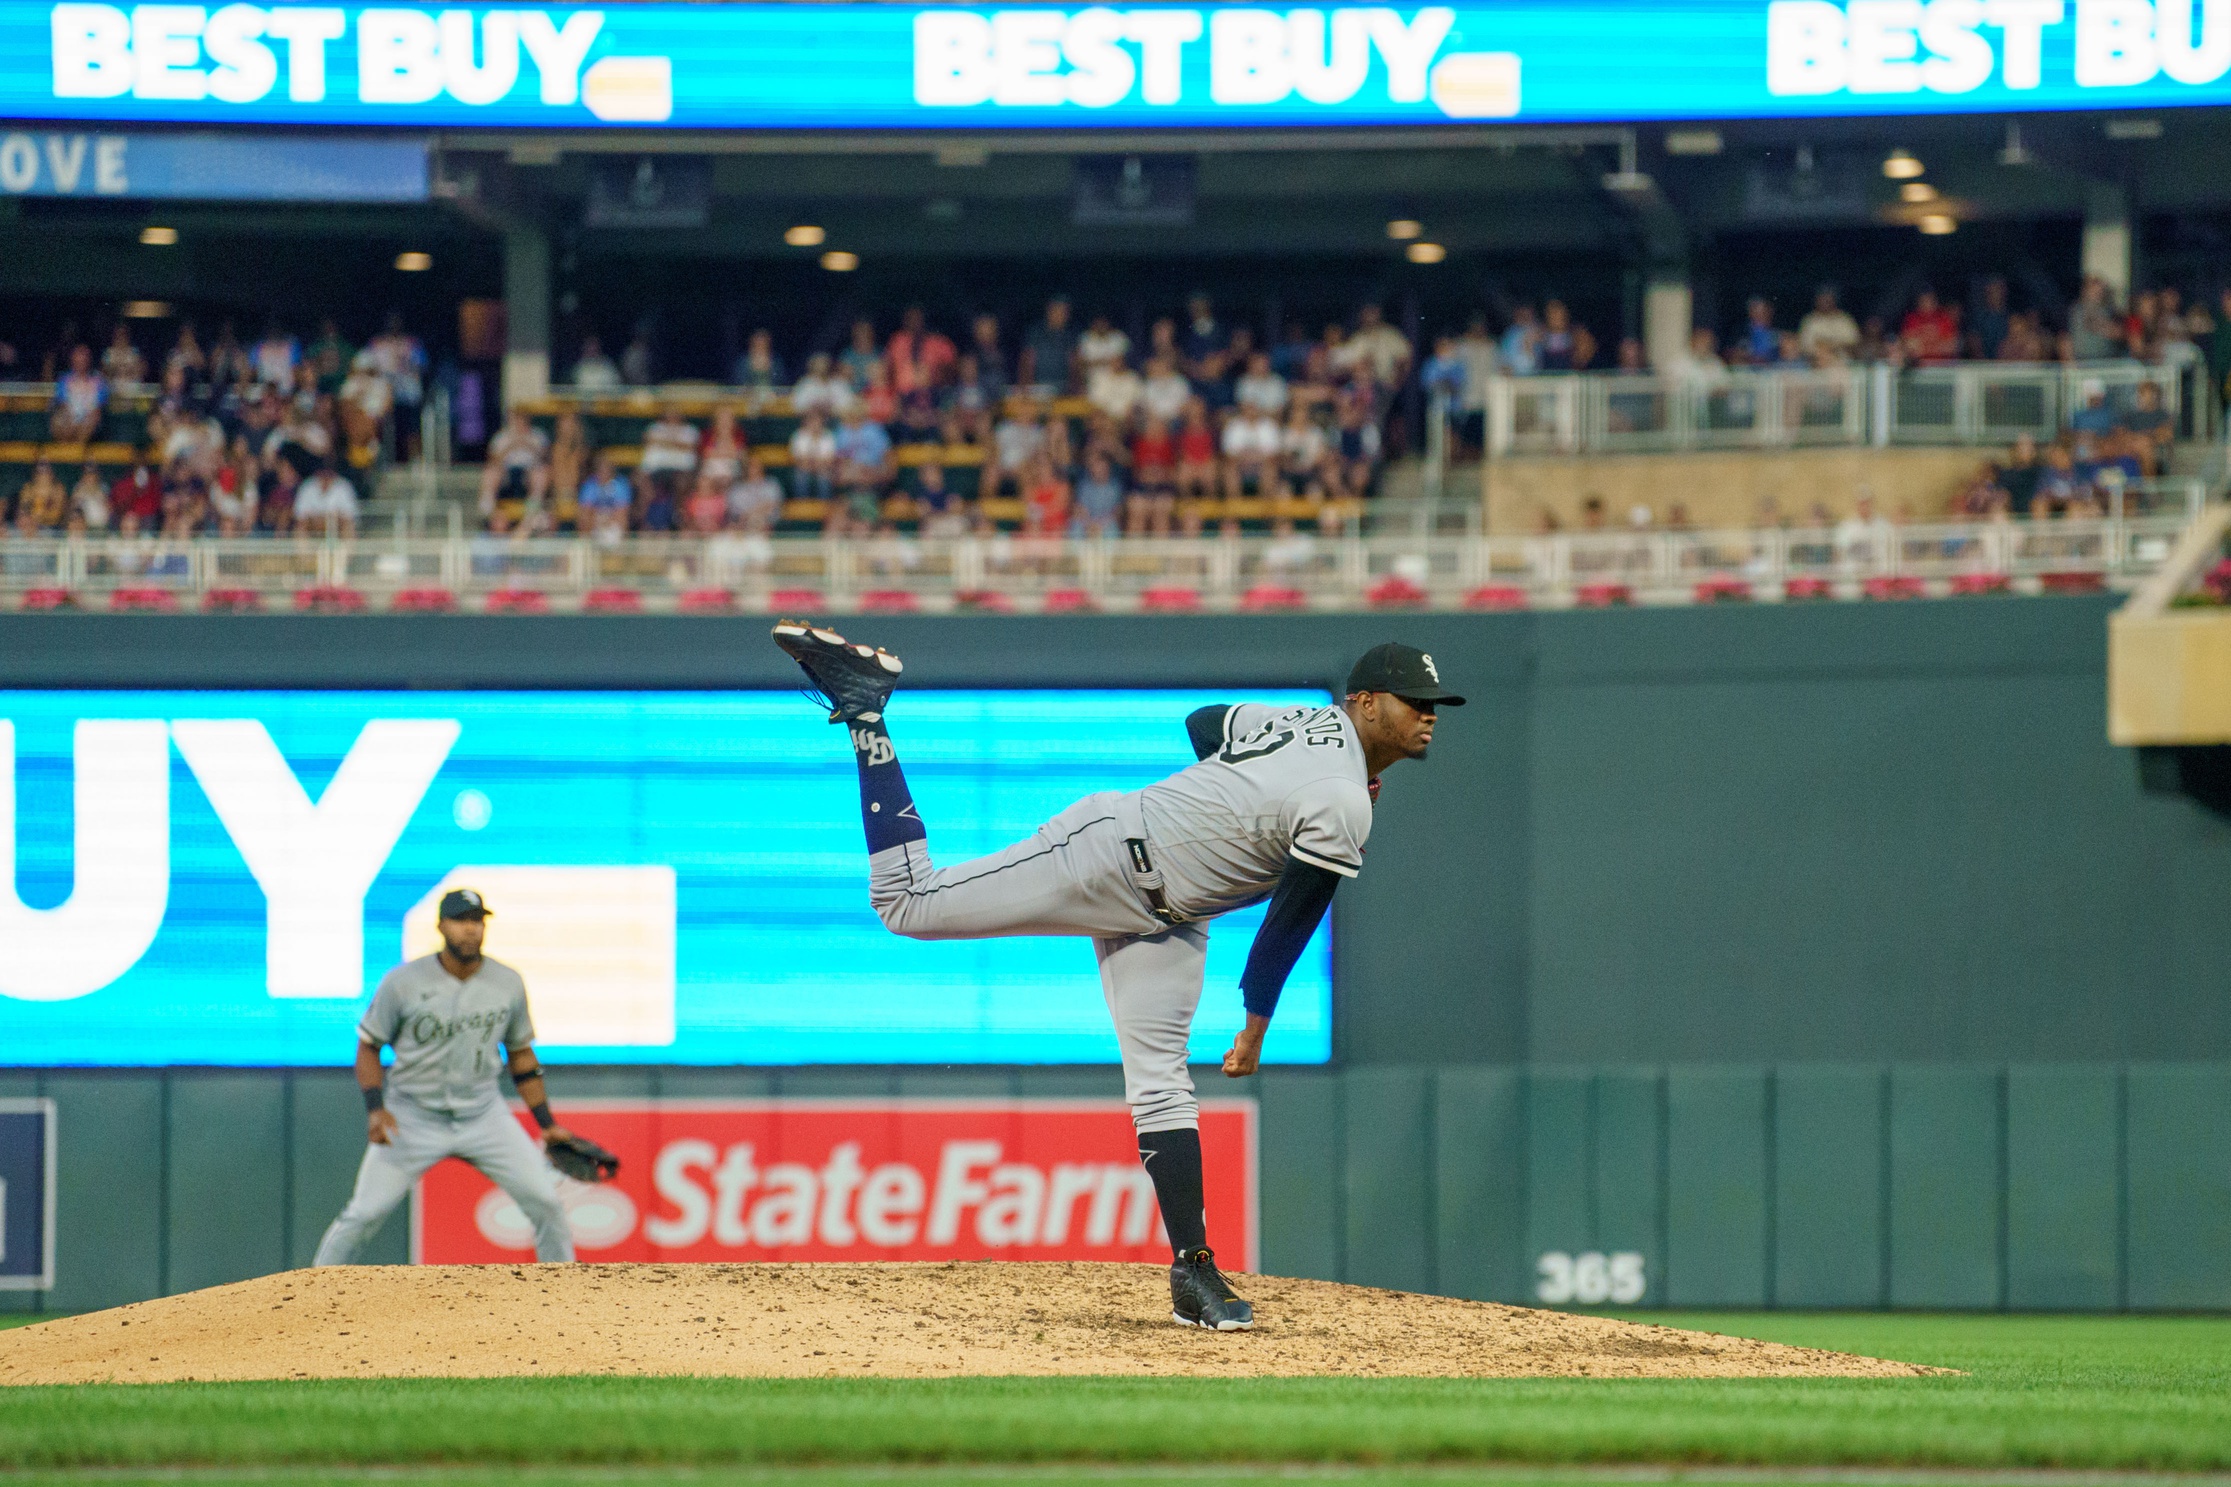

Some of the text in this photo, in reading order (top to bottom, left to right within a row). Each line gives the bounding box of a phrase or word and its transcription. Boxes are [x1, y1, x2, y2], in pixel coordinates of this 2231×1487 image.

[51, 3, 606, 106] BEST BUY
[913, 7, 1457, 107] BEST BUY
[1766, 0, 2231, 96] BEST BU
[0, 132, 129, 194] OVE
[0, 718, 462, 1002] UY
[412, 1008, 508, 1045] Chicago
[1536, 1251, 1647, 1304] 365
